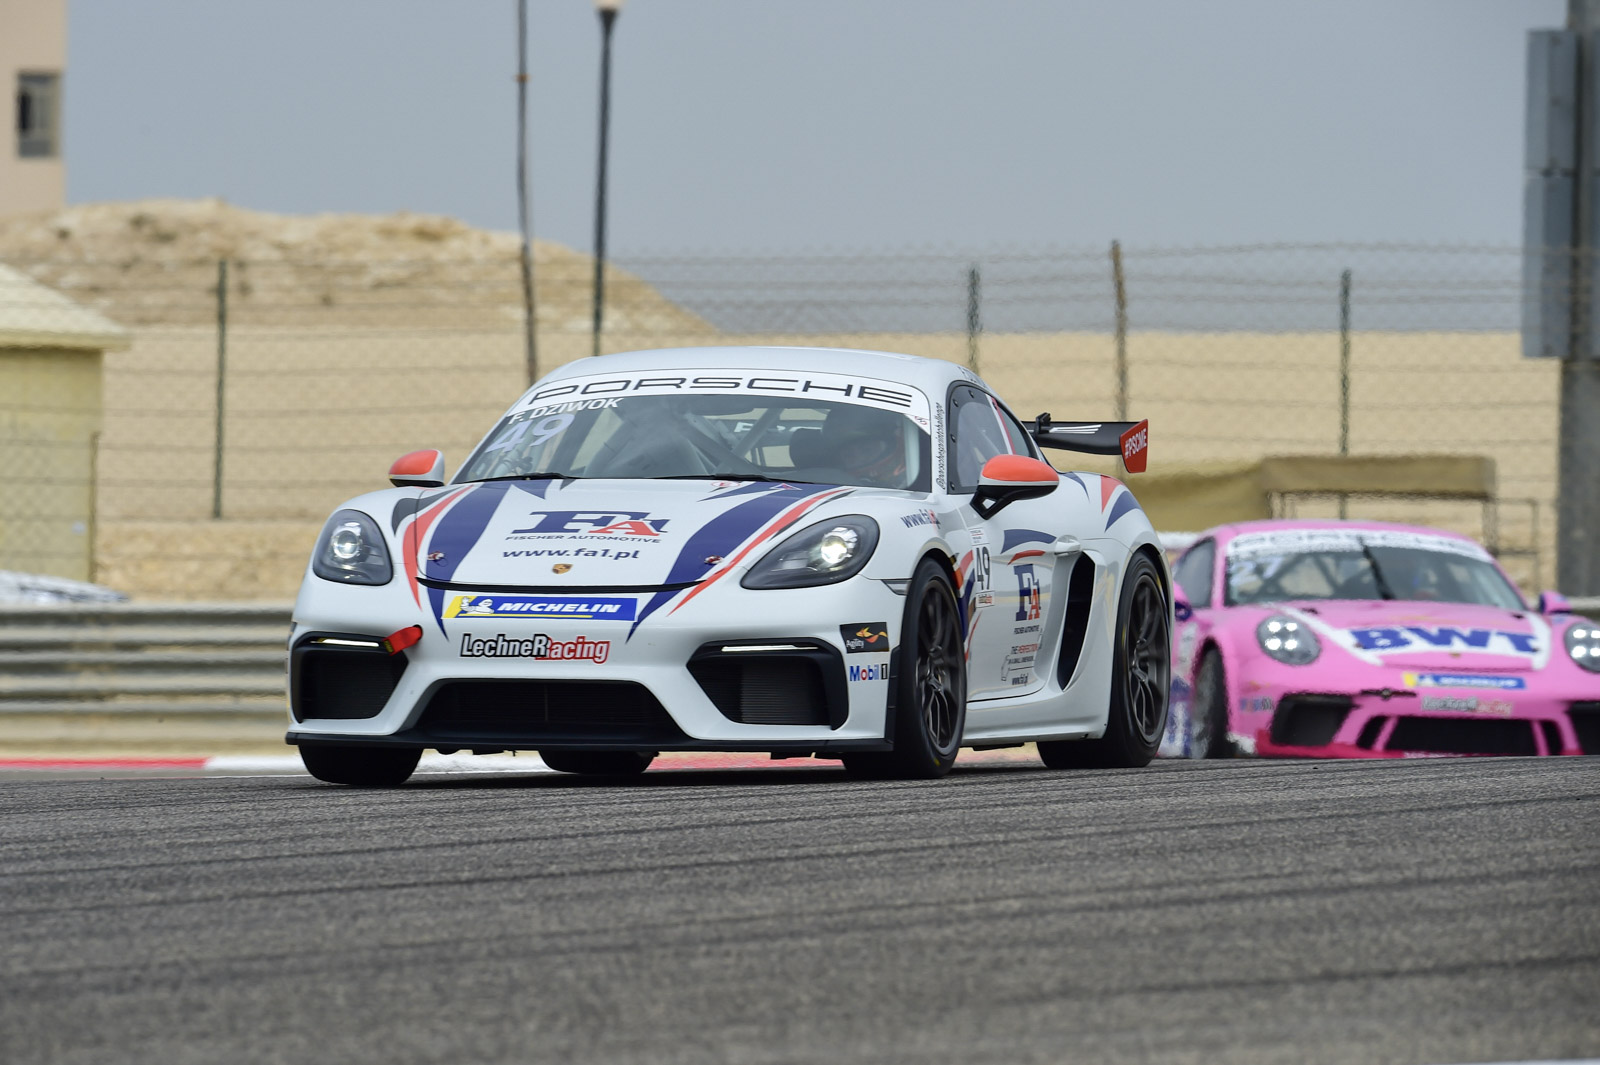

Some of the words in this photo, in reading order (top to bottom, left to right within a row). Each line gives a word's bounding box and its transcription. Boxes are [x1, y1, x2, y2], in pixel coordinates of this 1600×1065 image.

[528, 377, 913, 408] PORSCHE
[509, 412, 524, 425] F.
[530, 397, 624, 419] DZIWOK
[486, 414, 576, 453] 49
[567, 535, 662, 543] AUTOMOTIVE
[502, 548, 640, 560] www.fa1.pl
[976, 546, 991, 590] 49
[497, 602, 622, 613] MICHELIN
[849, 663, 880, 682] Mobil
[880, 663, 888, 680] 1
